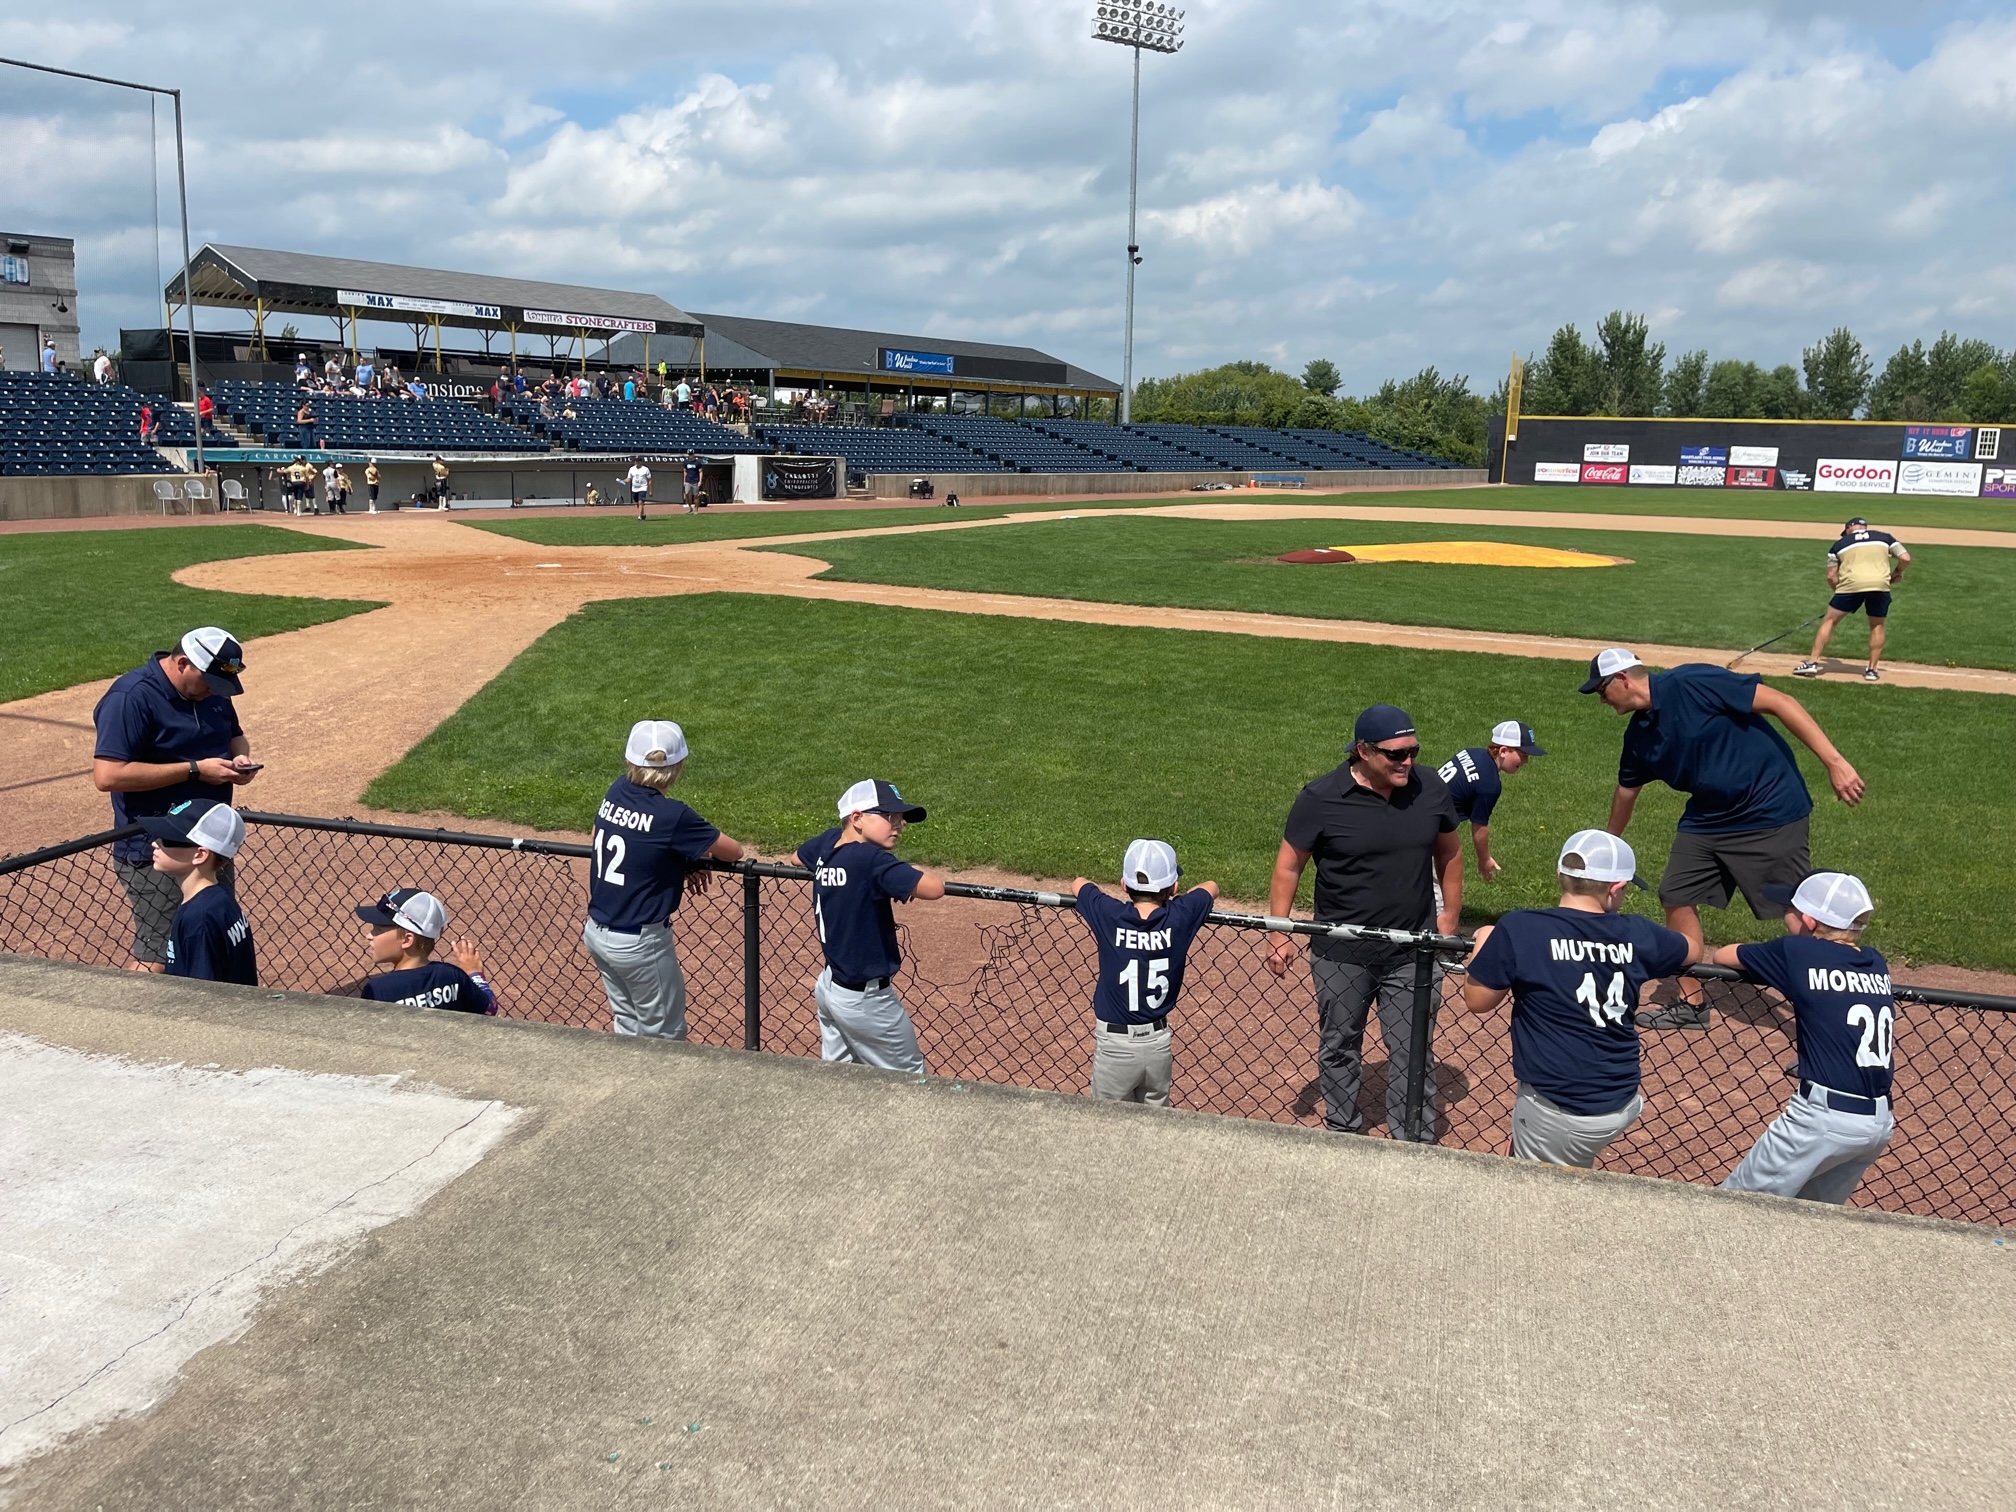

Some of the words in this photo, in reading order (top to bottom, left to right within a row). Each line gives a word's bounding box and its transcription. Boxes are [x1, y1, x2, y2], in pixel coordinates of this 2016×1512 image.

[366, 295, 394, 308] MAX
[475, 306, 499, 318] MAX
[565, 315, 654, 331] STONECRAFTERS
[1818, 464, 1892, 480] Gordon
[1925, 470, 1977, 479] GEMINI
[594, 828, 626, 886] 12
[1115, 927, 1171, 950] FERRY
[1550, 938, 1633, 965] MUTTON
[1119, 958, 1170, 1012] 15
[1808, 967, 1892, 996] MORRISO
[394, 983, 459, 1008] DERSON
[1575, 971, 1628, 1028] 14
[1846, 1003, 1893, 1069] 20
